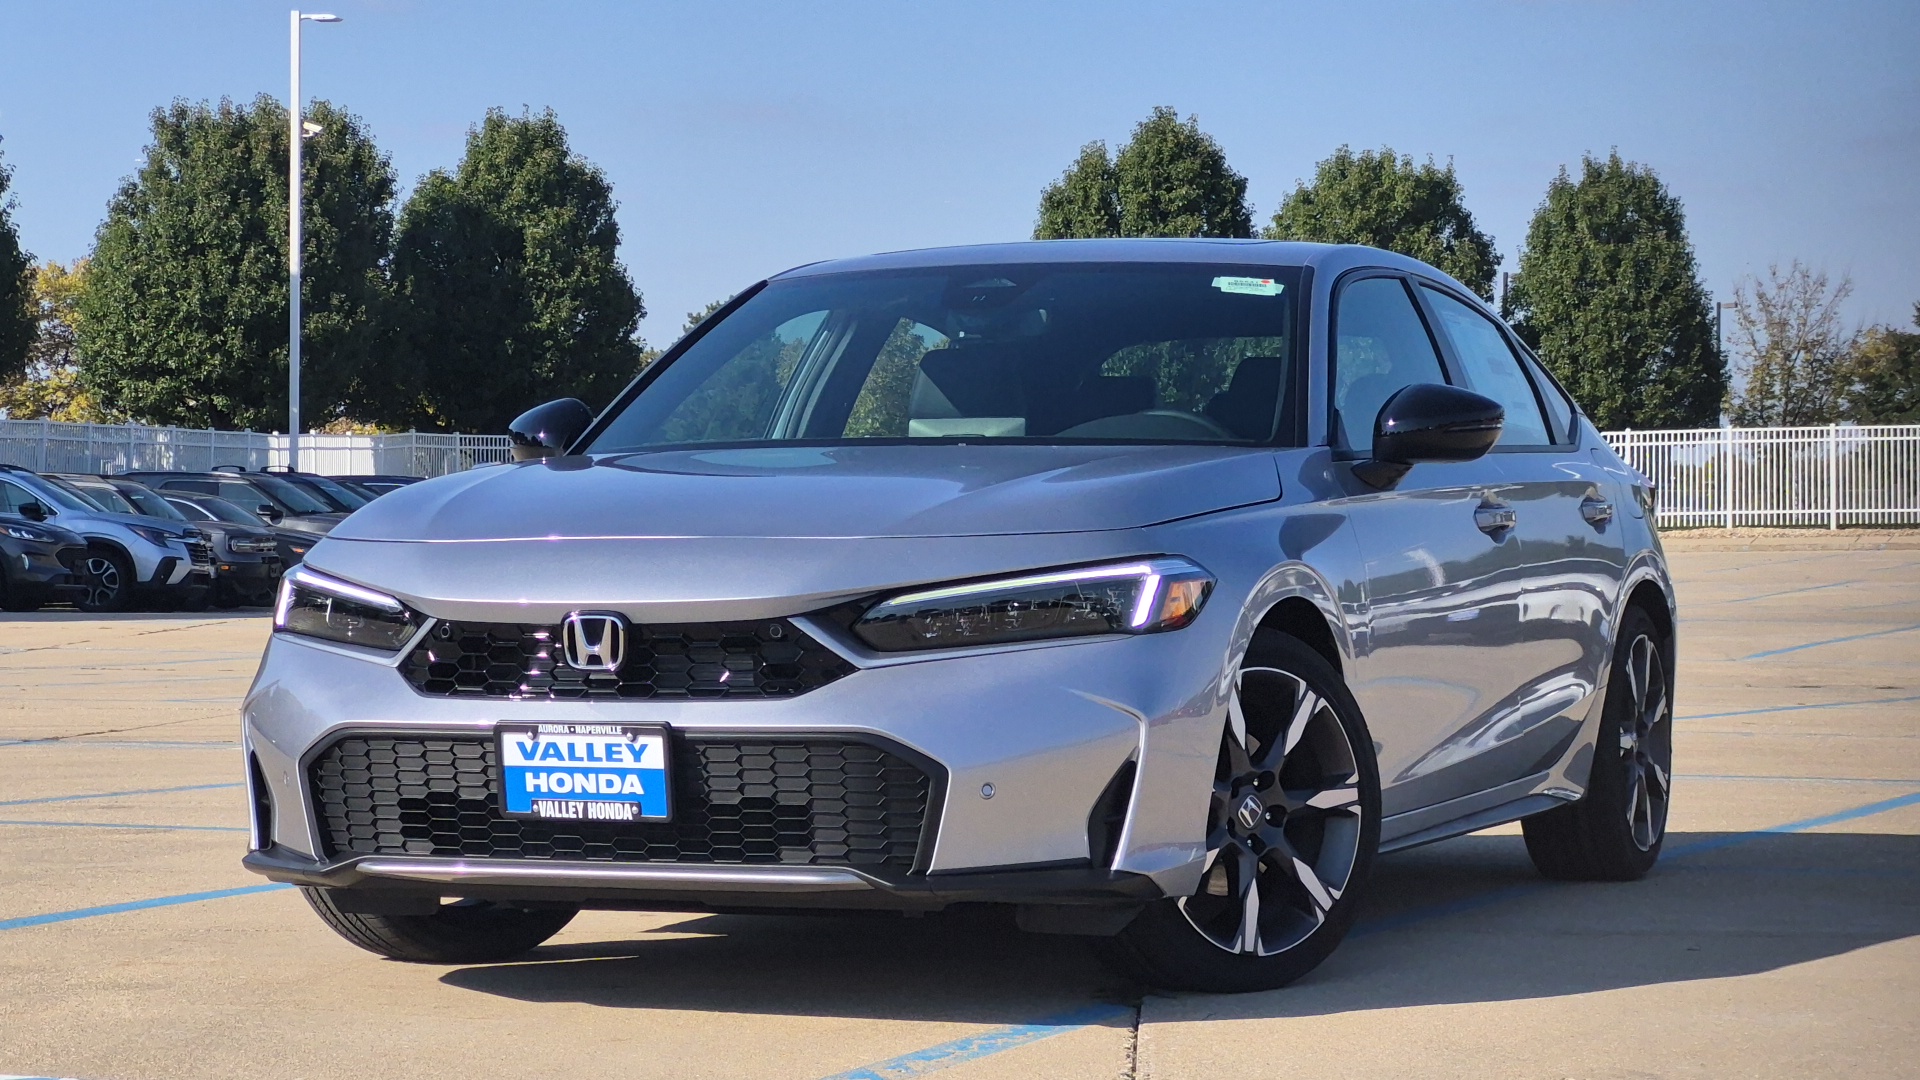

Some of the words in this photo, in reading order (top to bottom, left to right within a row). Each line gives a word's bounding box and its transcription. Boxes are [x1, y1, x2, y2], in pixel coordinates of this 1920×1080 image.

[538, 725, 569, 734] AURORA
[575, 725, 622, 735] NAPERVILLE
[515, 741, 649, 763] VALLEY
[525, 772, 645, 795] HONDA
[538, 800, 584, 819] VALLEY
[587, 802, 633, 820] HONDA
